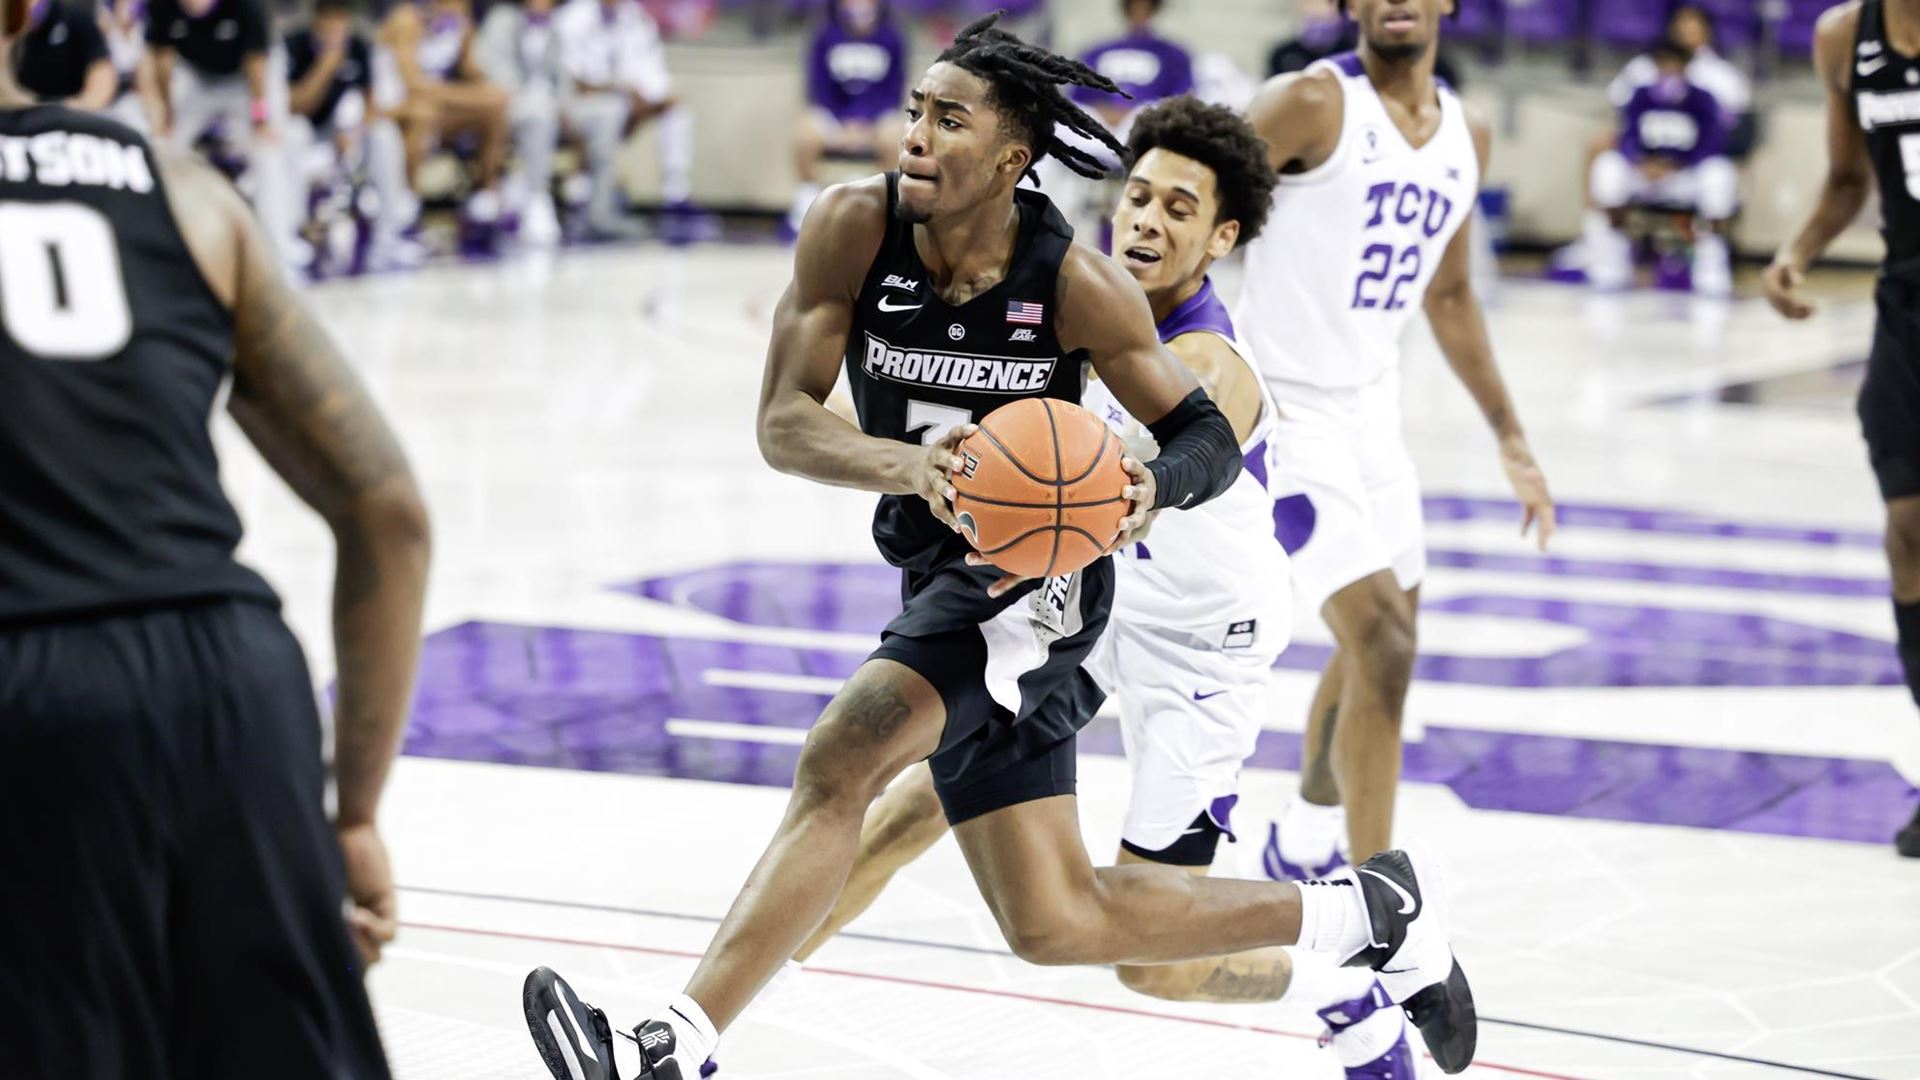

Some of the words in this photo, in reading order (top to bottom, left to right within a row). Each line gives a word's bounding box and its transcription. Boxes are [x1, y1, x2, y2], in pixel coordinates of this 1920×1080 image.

[0, 130, 154, 194] TSON
[1365, 181, 1453, 239] TCU
[0, 200, 134, 360] 0
[882, 274, 919, 292] BLM
[1351, 242, 1420, 311] 22
[864, 336, 1052, 391] PROVIDENCE
